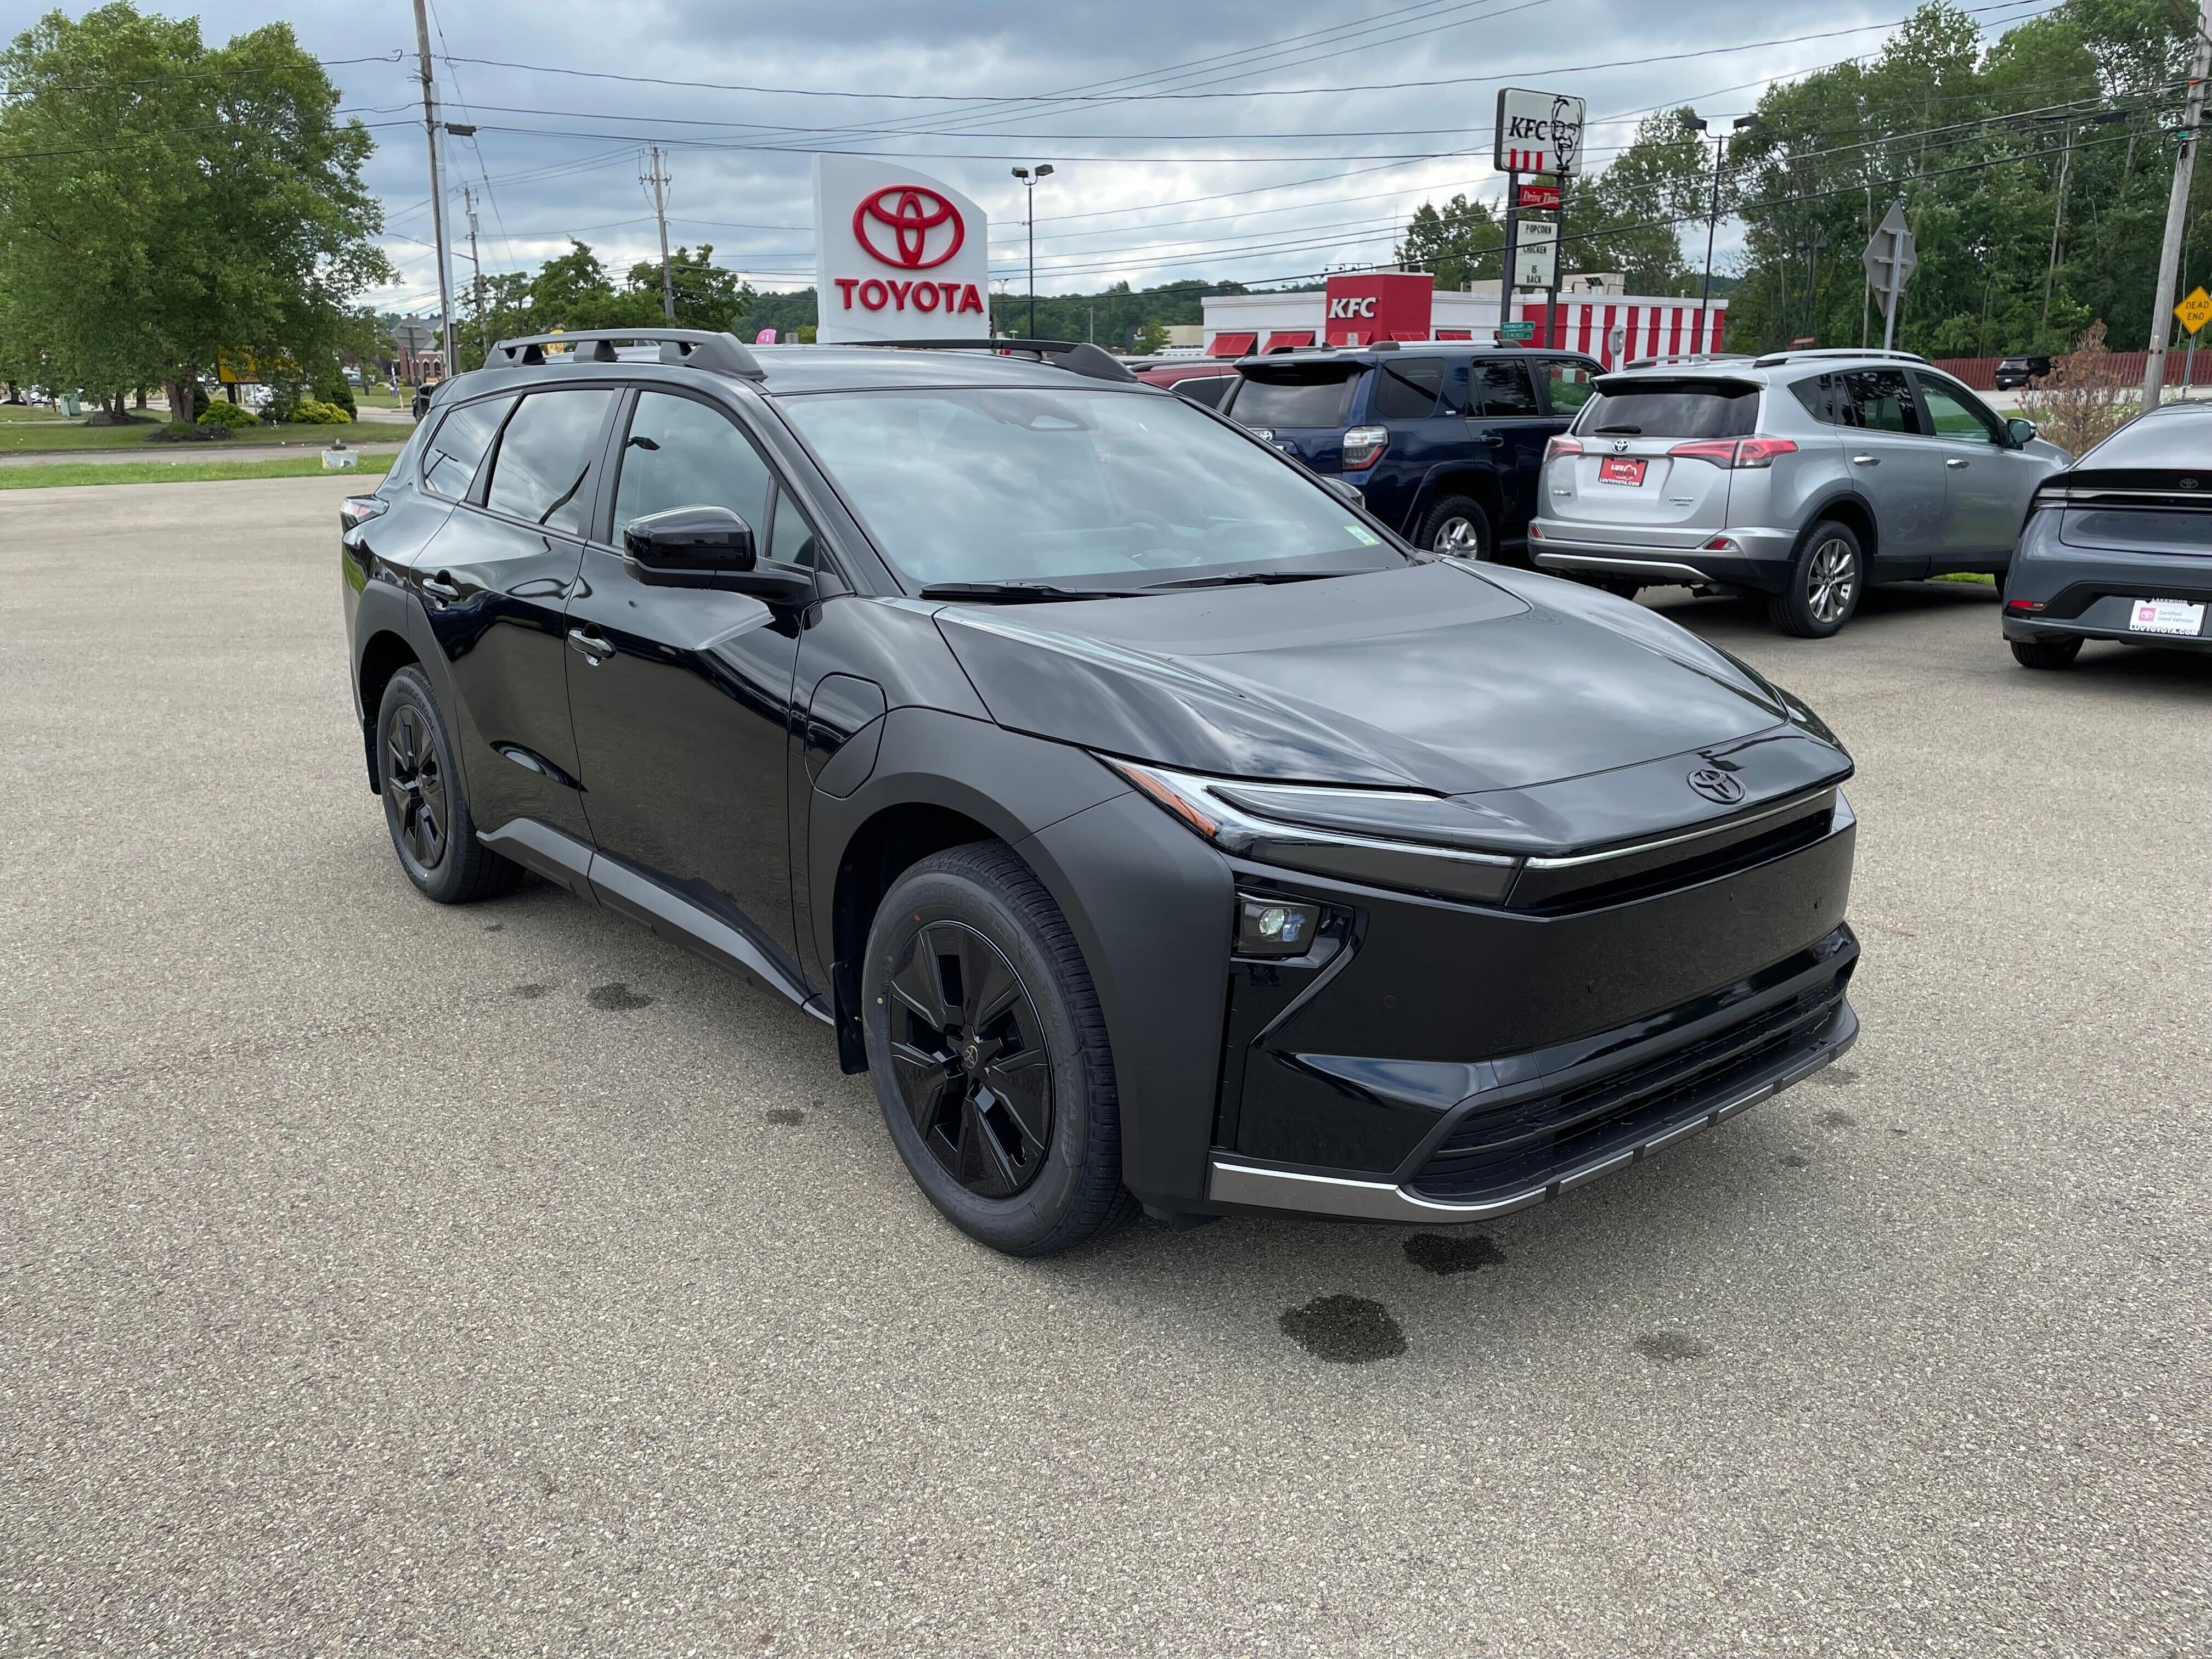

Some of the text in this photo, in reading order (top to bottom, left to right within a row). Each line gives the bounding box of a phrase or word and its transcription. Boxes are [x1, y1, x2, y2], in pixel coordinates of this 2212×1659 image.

[1508, 116, 1548, 140] KFC
[1526, 224, 1551, 234] POPCORN
[1523, 245, 1547, 254] CHICKEN
[1531, 265, 1537, 273] IS
[1527, 275, 1542, 284] BACK
[834, 278, 984, 314] TOYOTA
[1328, 297, 1377, 318] KFC
[2187, 312, 2204, 320] END
[1599, 477, 1640, 487] LUVTOYOTA.COM
[2129, 625, 2198, 636] LUVTOYOTA.COM
